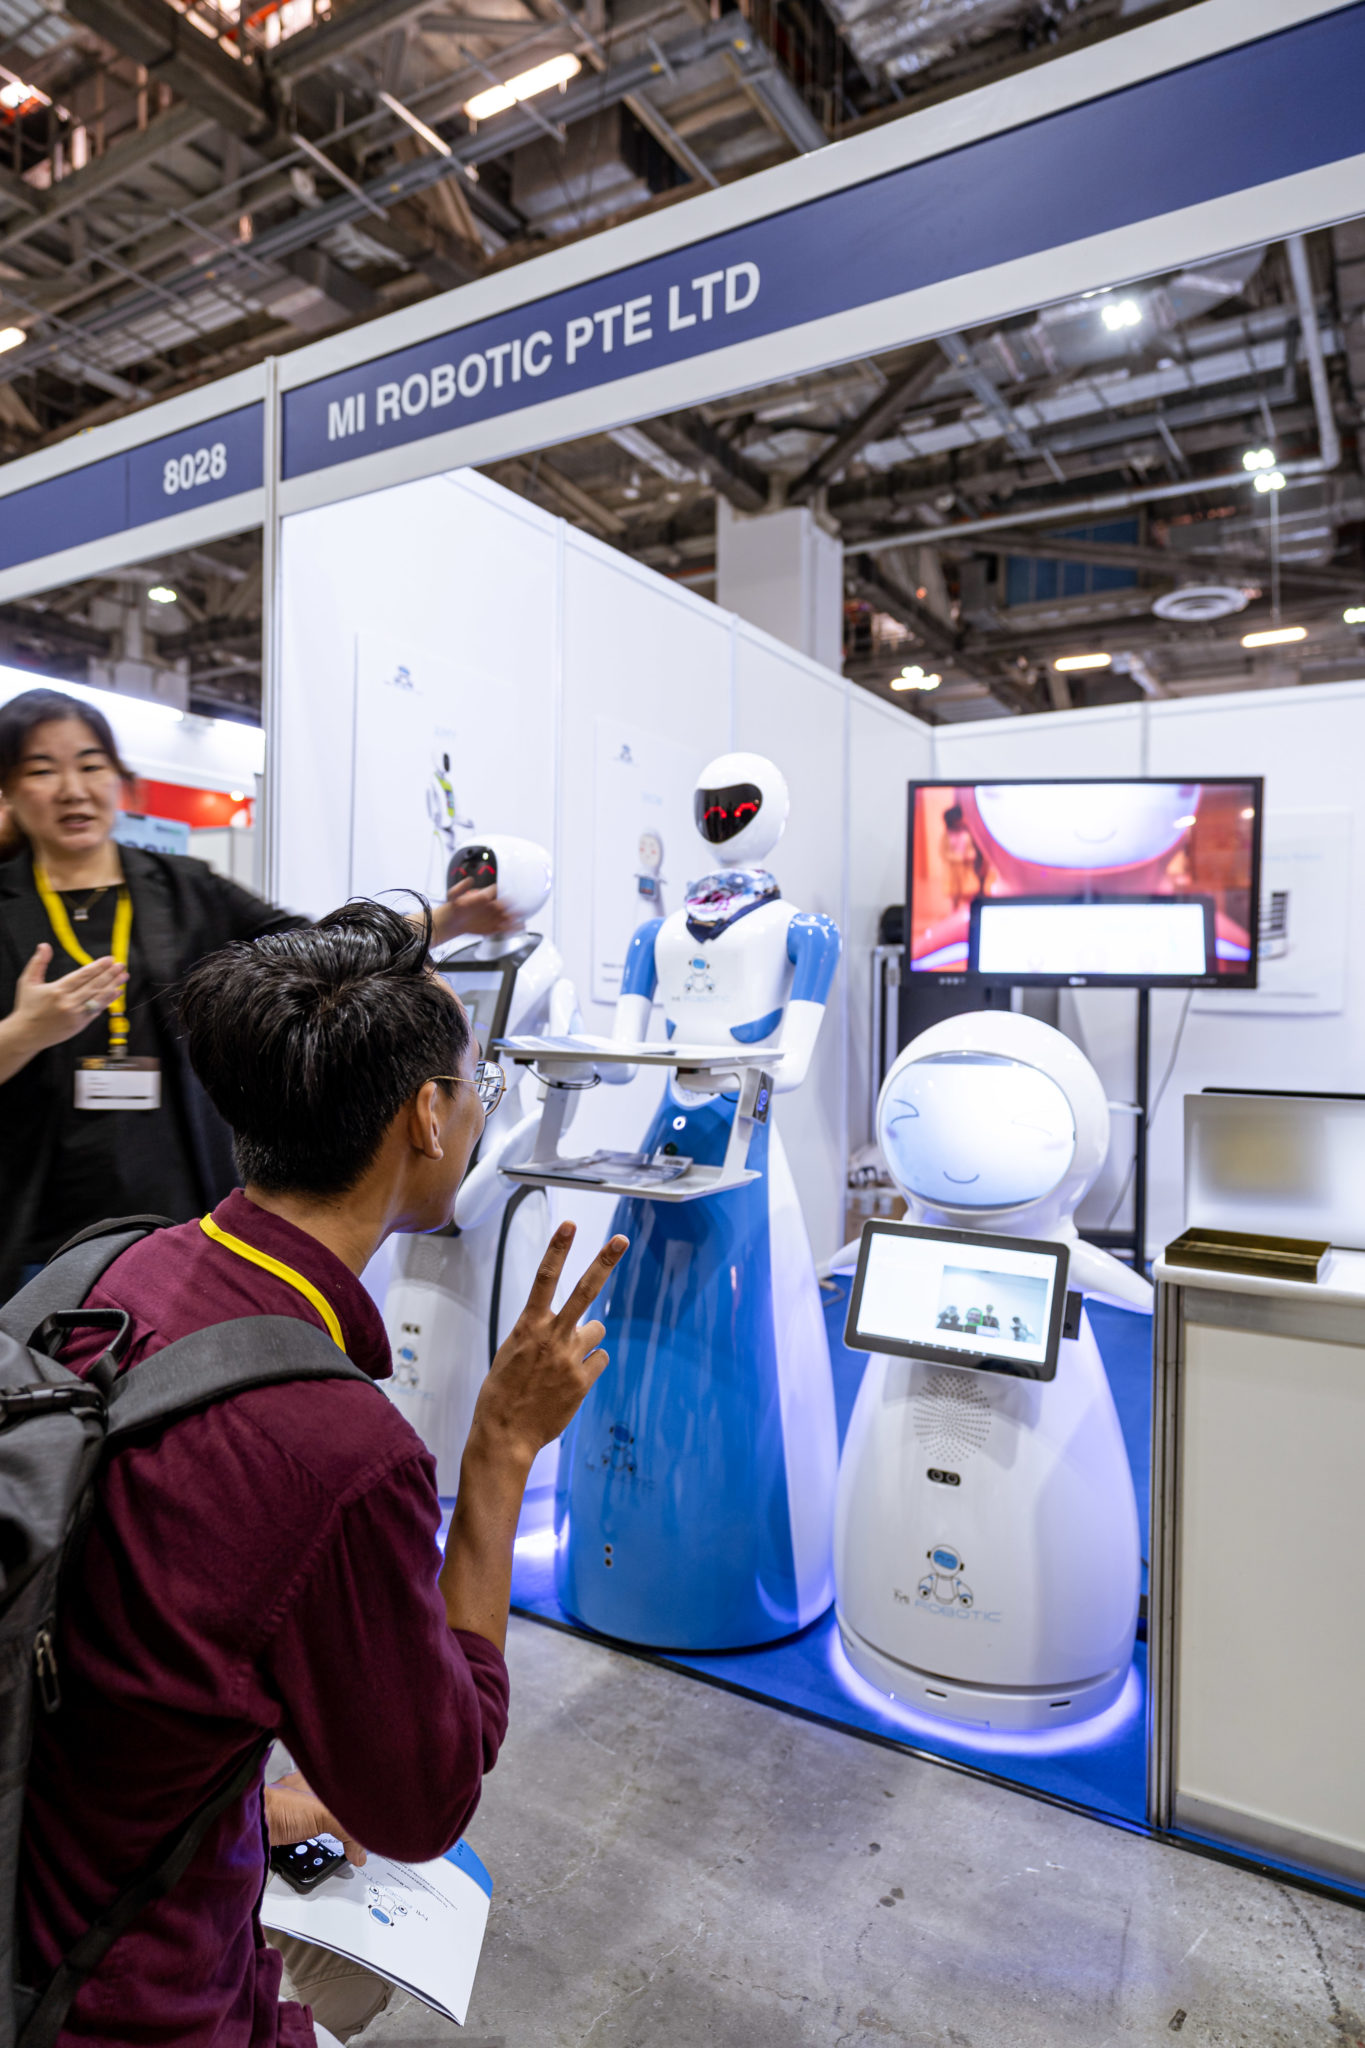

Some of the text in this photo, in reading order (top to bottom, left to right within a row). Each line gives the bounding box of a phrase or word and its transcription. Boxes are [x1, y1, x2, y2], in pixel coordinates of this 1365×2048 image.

[328, 261, 761, 441] MI ROBOTIC PTE LTD
[163, 442, 227, 495] 8028
[914, 1599, 1001, 1623] ROBOTIC
